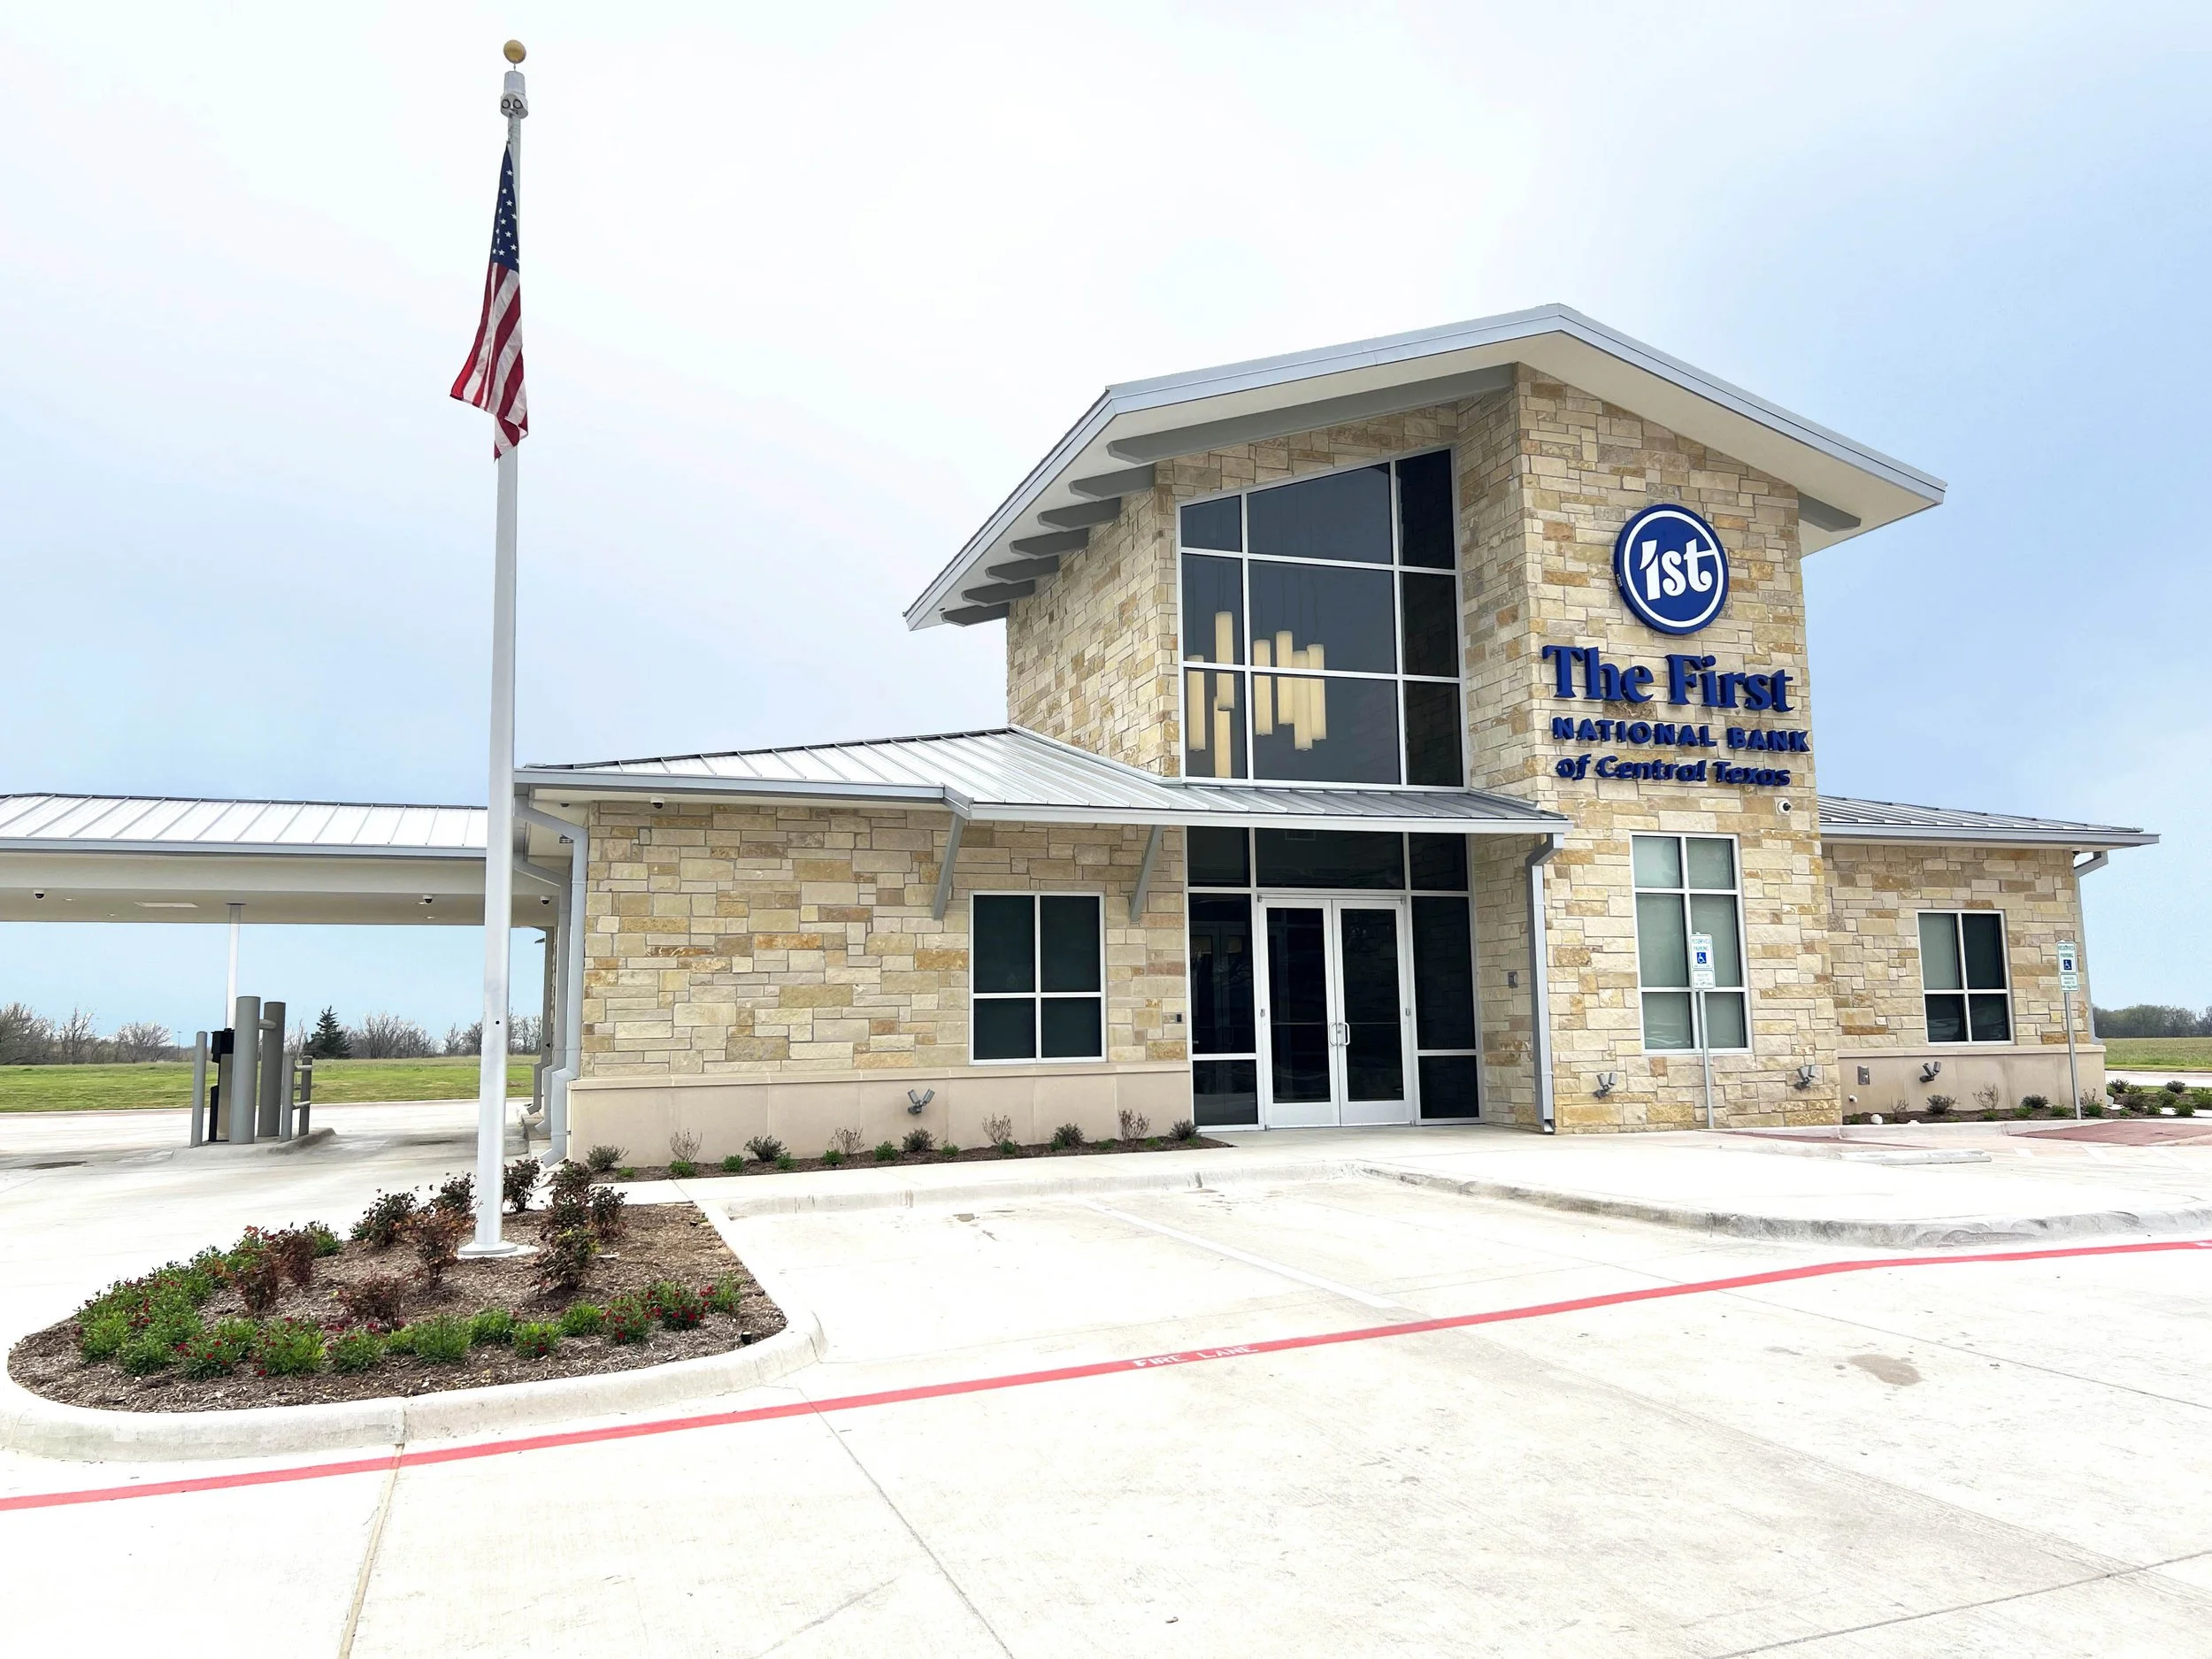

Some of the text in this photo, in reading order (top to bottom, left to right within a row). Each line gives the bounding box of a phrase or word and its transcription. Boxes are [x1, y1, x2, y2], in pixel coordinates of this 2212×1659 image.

[1542, 645, 1794, 712] The First
[1552, 717, 1810, 752] NATIONAL BANK
[1555, 754, 1791, 786] of Central Texas
[1133, 1345, 1258, 1367] FIRE LANE
